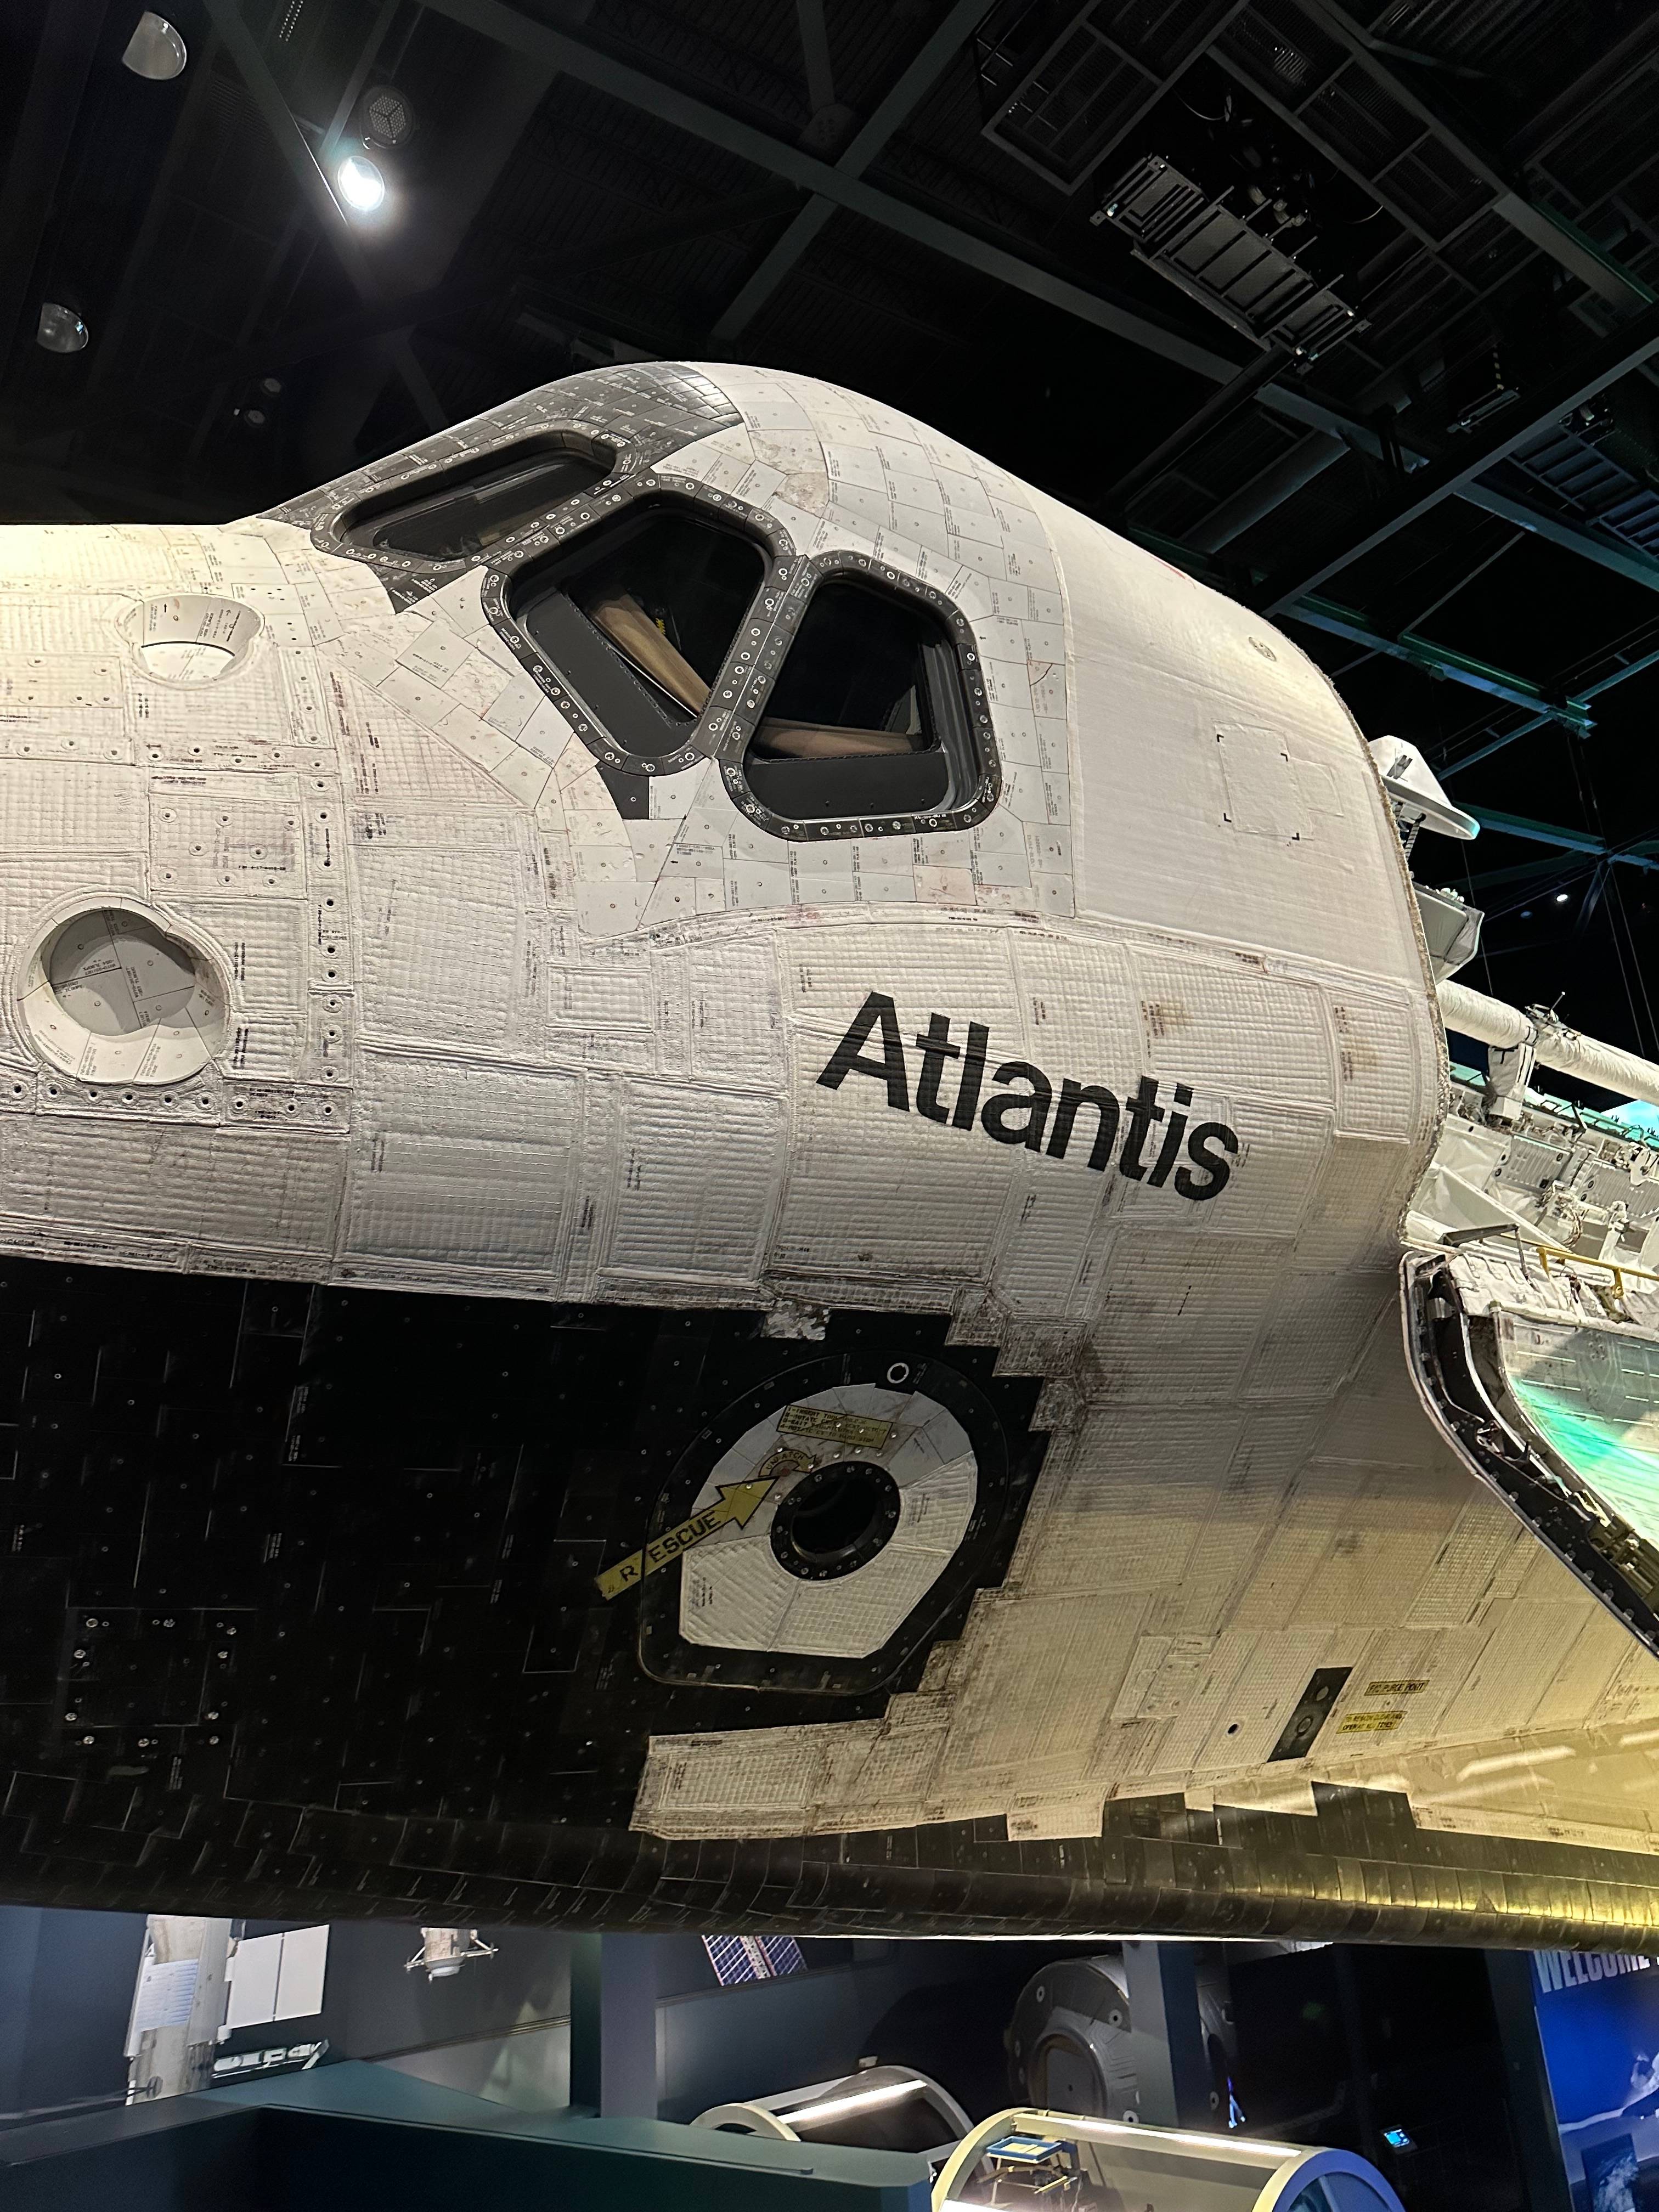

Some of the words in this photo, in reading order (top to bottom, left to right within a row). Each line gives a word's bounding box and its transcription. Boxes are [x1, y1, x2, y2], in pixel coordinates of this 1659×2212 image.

[816, 991, 1238, 1200] Atlantis
[766, 1451, 804, 1470] UNATCH
[1534, 1950, 1650, 1993] WELCO
